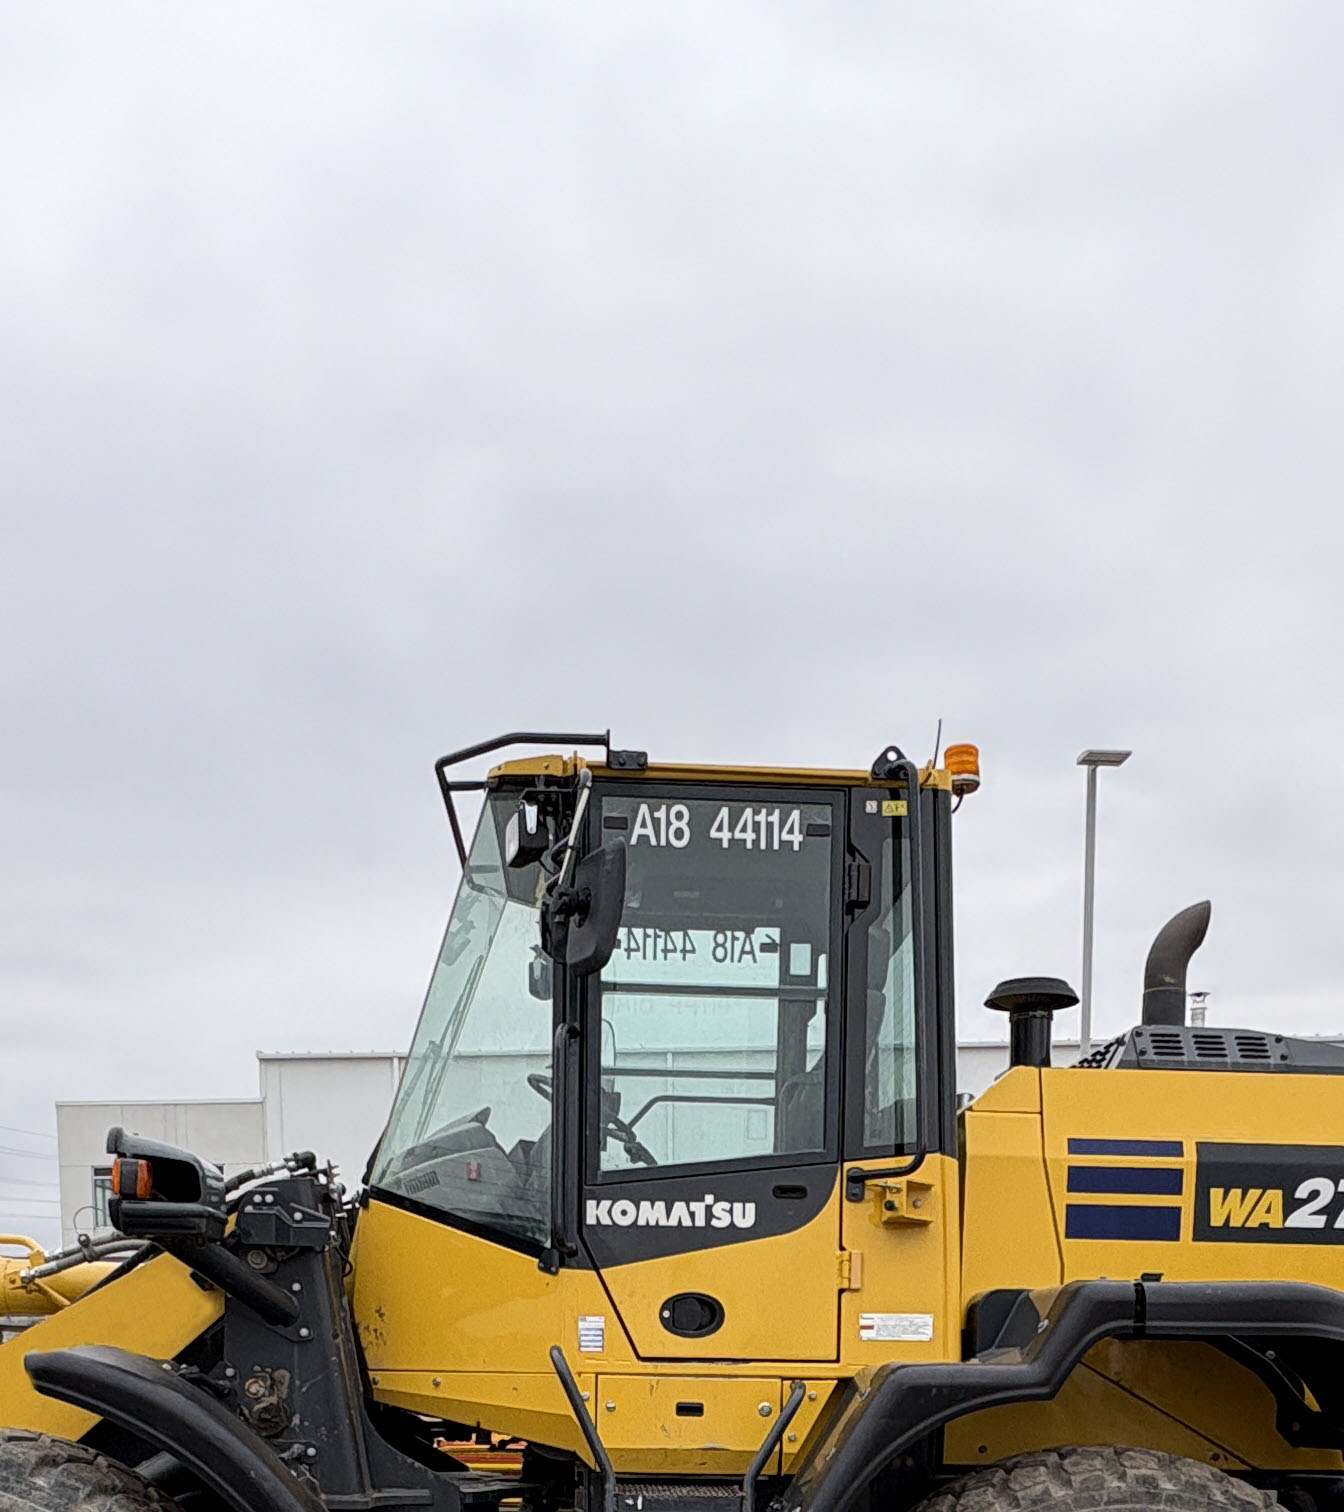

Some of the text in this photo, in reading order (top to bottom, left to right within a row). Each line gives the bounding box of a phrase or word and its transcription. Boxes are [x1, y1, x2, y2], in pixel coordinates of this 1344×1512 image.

[630, 803, 803, 851] A18 44114
[586, 1194, 756, 1229] KOMATSU
